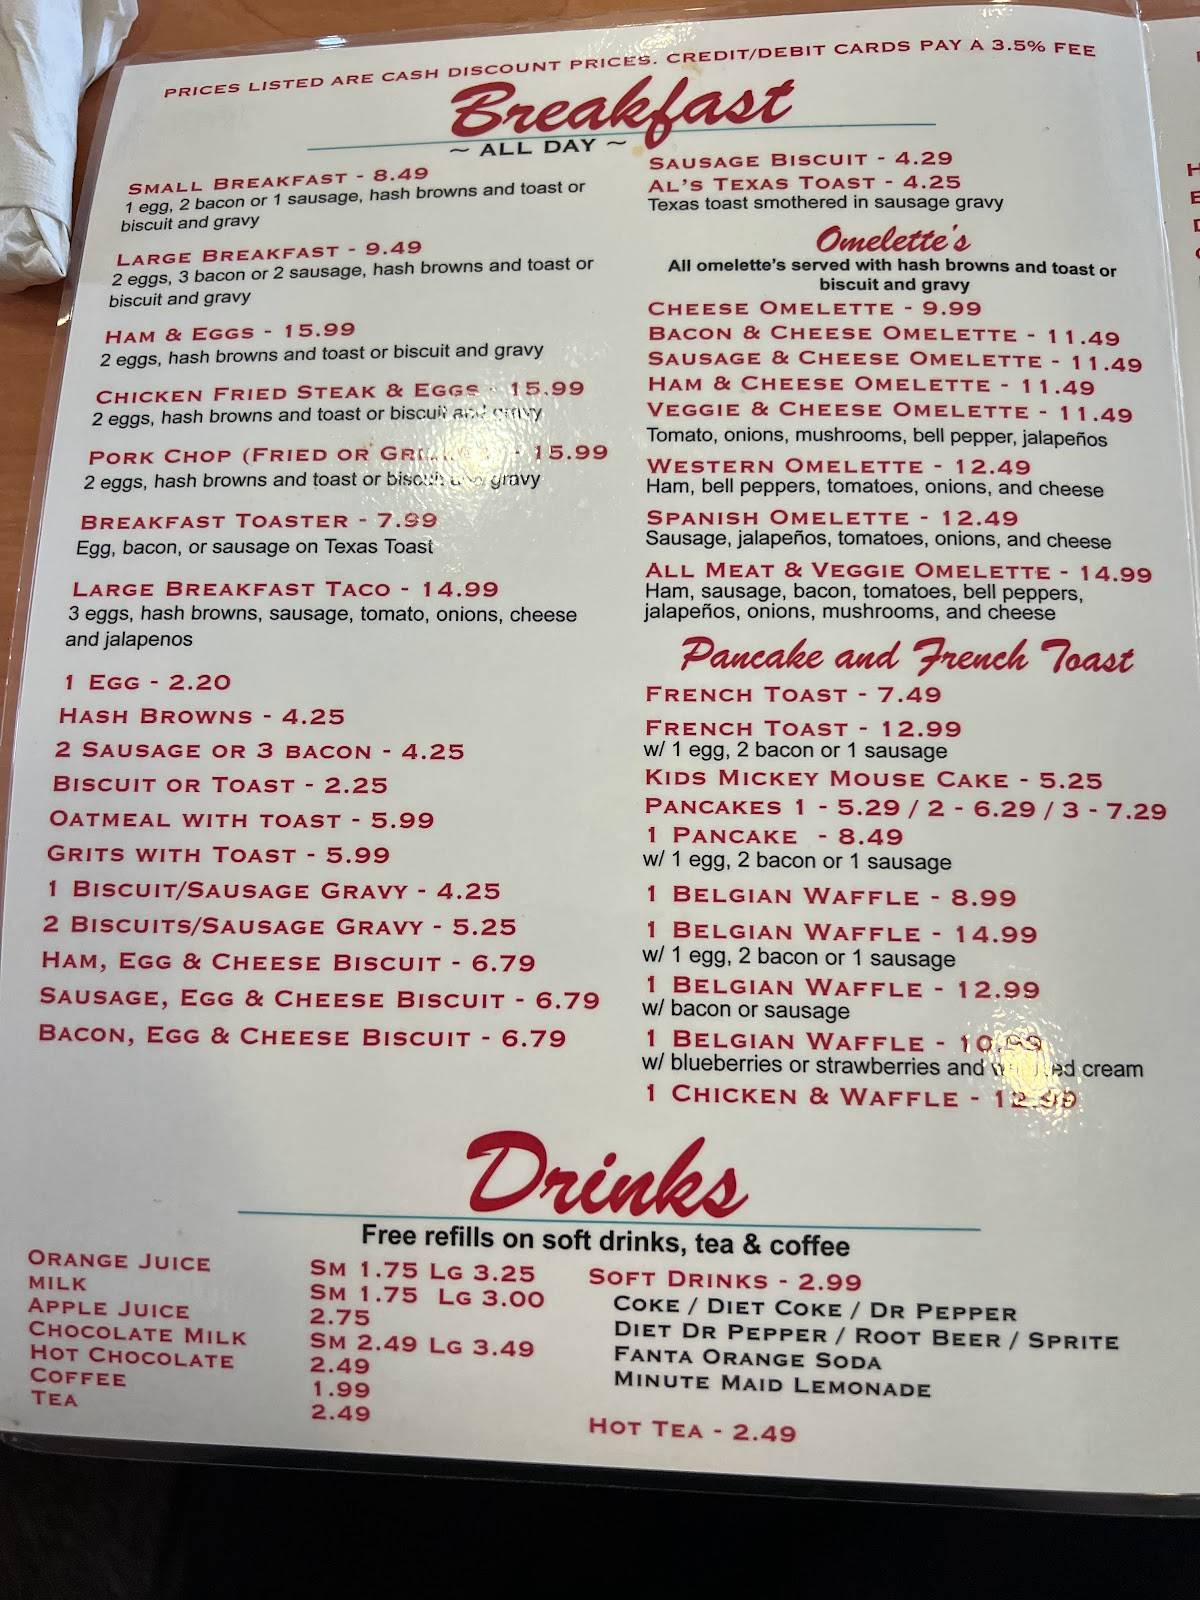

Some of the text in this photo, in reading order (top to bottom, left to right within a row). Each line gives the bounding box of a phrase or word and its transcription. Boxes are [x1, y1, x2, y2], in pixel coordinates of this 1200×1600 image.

[164, 39, 1096, 98] PRICES LISTED ARE CASH DISCOUNT PRICES. CREDIT/DEBIT CARDS PAY A 3.5% FEE
[450, 75, 795, 149] Breakfast
[479, 138, 597, 157] ALL DAY
[895, 151, 953, 166] 4.29
[373, 167, 429, 182] 8.49
[903, 175, 961, 189] 4.25
[126, 181, 586, 215] 1 egg, 2 bacon or 1 sausage, hash browns and toast or
[647, 194, 1004, 212] Texas toast smothered in sausage gravy
[121, 215, 260, 232] biscuit and gravy
[366, 240, 422, 256] 9.49
[816, 224, 971, 253] Omelette's
[668, 258, 1117, 278] All omelette's served with hash browns and toast or
[820, 277, 970, 295] biscuit and gravy
[923, 301, 982, 316] 9.99
[165, 328, 182, 342] &
[285, 322, 355, 338] 15.99
[751, 401, 768, 416] &
[1061, 405, 1133, 423] 11.49
[646, 426, 1108, 449] Tomato, onions, mushrooms, bell pepper, jalapeños
[76, 538, 434, 559] Egg, bacon, or sausage on Texas Toast
[680, 636, 1134, 677] Pancake and French Toast
[66, 674, 73, 690] 1
[169, 674, 231, 691] 2.20
[882, 720, 962, 738] 12.99
[1040, 772, 1103, 790] 5.25
[371, 812, 434, 829] 5.99
[49, 880, 56, 897] 1
[437, 882, 500, 900] 4.25
[648, 884, 655, 902] 1
[951, 889, 1016, 907] 8.99
[183, 952, 201, 970] &
[472, 954, 535, 973] 6.79
[467, 1130, 749, 1218] Drinks
[362, 1223, 850, 1257] Free refills on soft drinks, tea & coffee
[361, 1261, 418, 1279] 1.75
[473, 1264, 535, 1283] 3.25
[798, 1273, 862, 1292] 2.99
[688, 1297, 698, 1316] /
[850, 1301, 861, 1320] /
[314, 1380, 370, 1399] 1.99
[733, 1424, 797, 1443] 2.49
